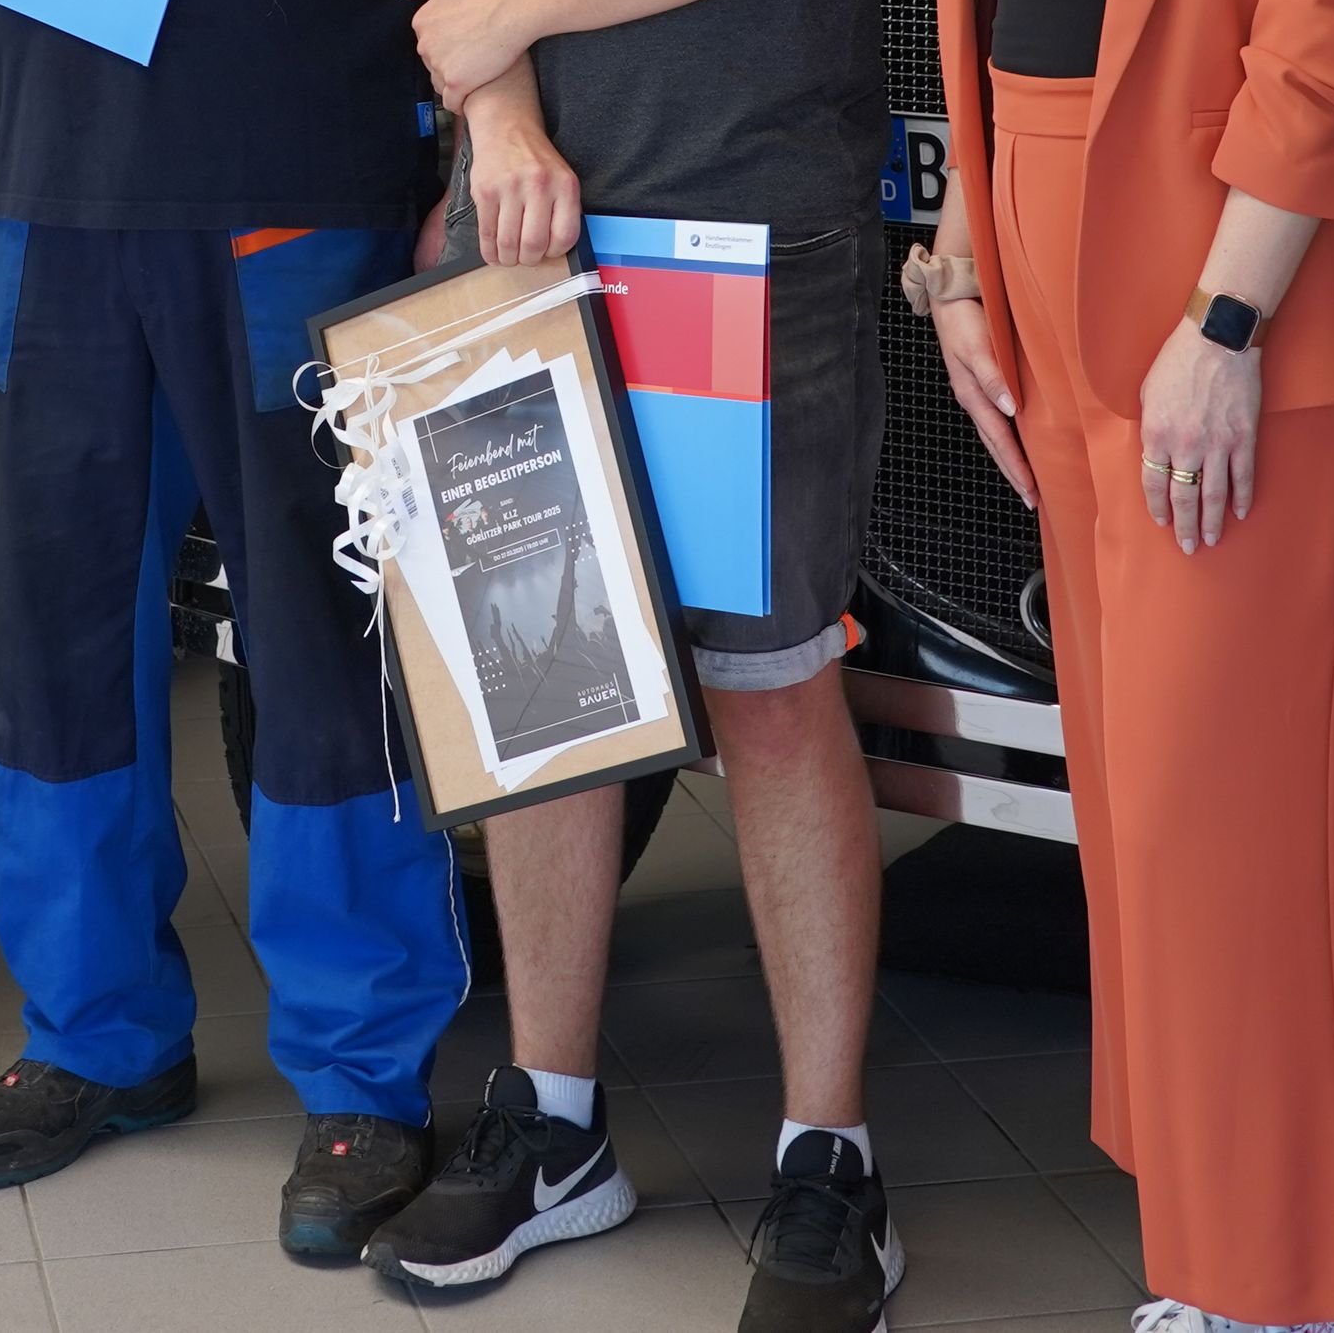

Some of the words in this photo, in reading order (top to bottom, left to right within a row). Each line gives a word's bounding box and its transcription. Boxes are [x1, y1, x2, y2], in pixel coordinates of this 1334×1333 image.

[881, 179, 897, 201] D
[517, 424, 544, 453] mit
[441, 482, 473, 504] EINER
[474, 449, 563, 492] BEGLEITPERSON
[503, 519, 522, 533] PARK
[522, 512, 543, 526] TOUR
[543, 504, 562, 519] 2025
[577, 681, 615, 697] AUTOHAUS
[579, 688, 617, 707] BAUER
